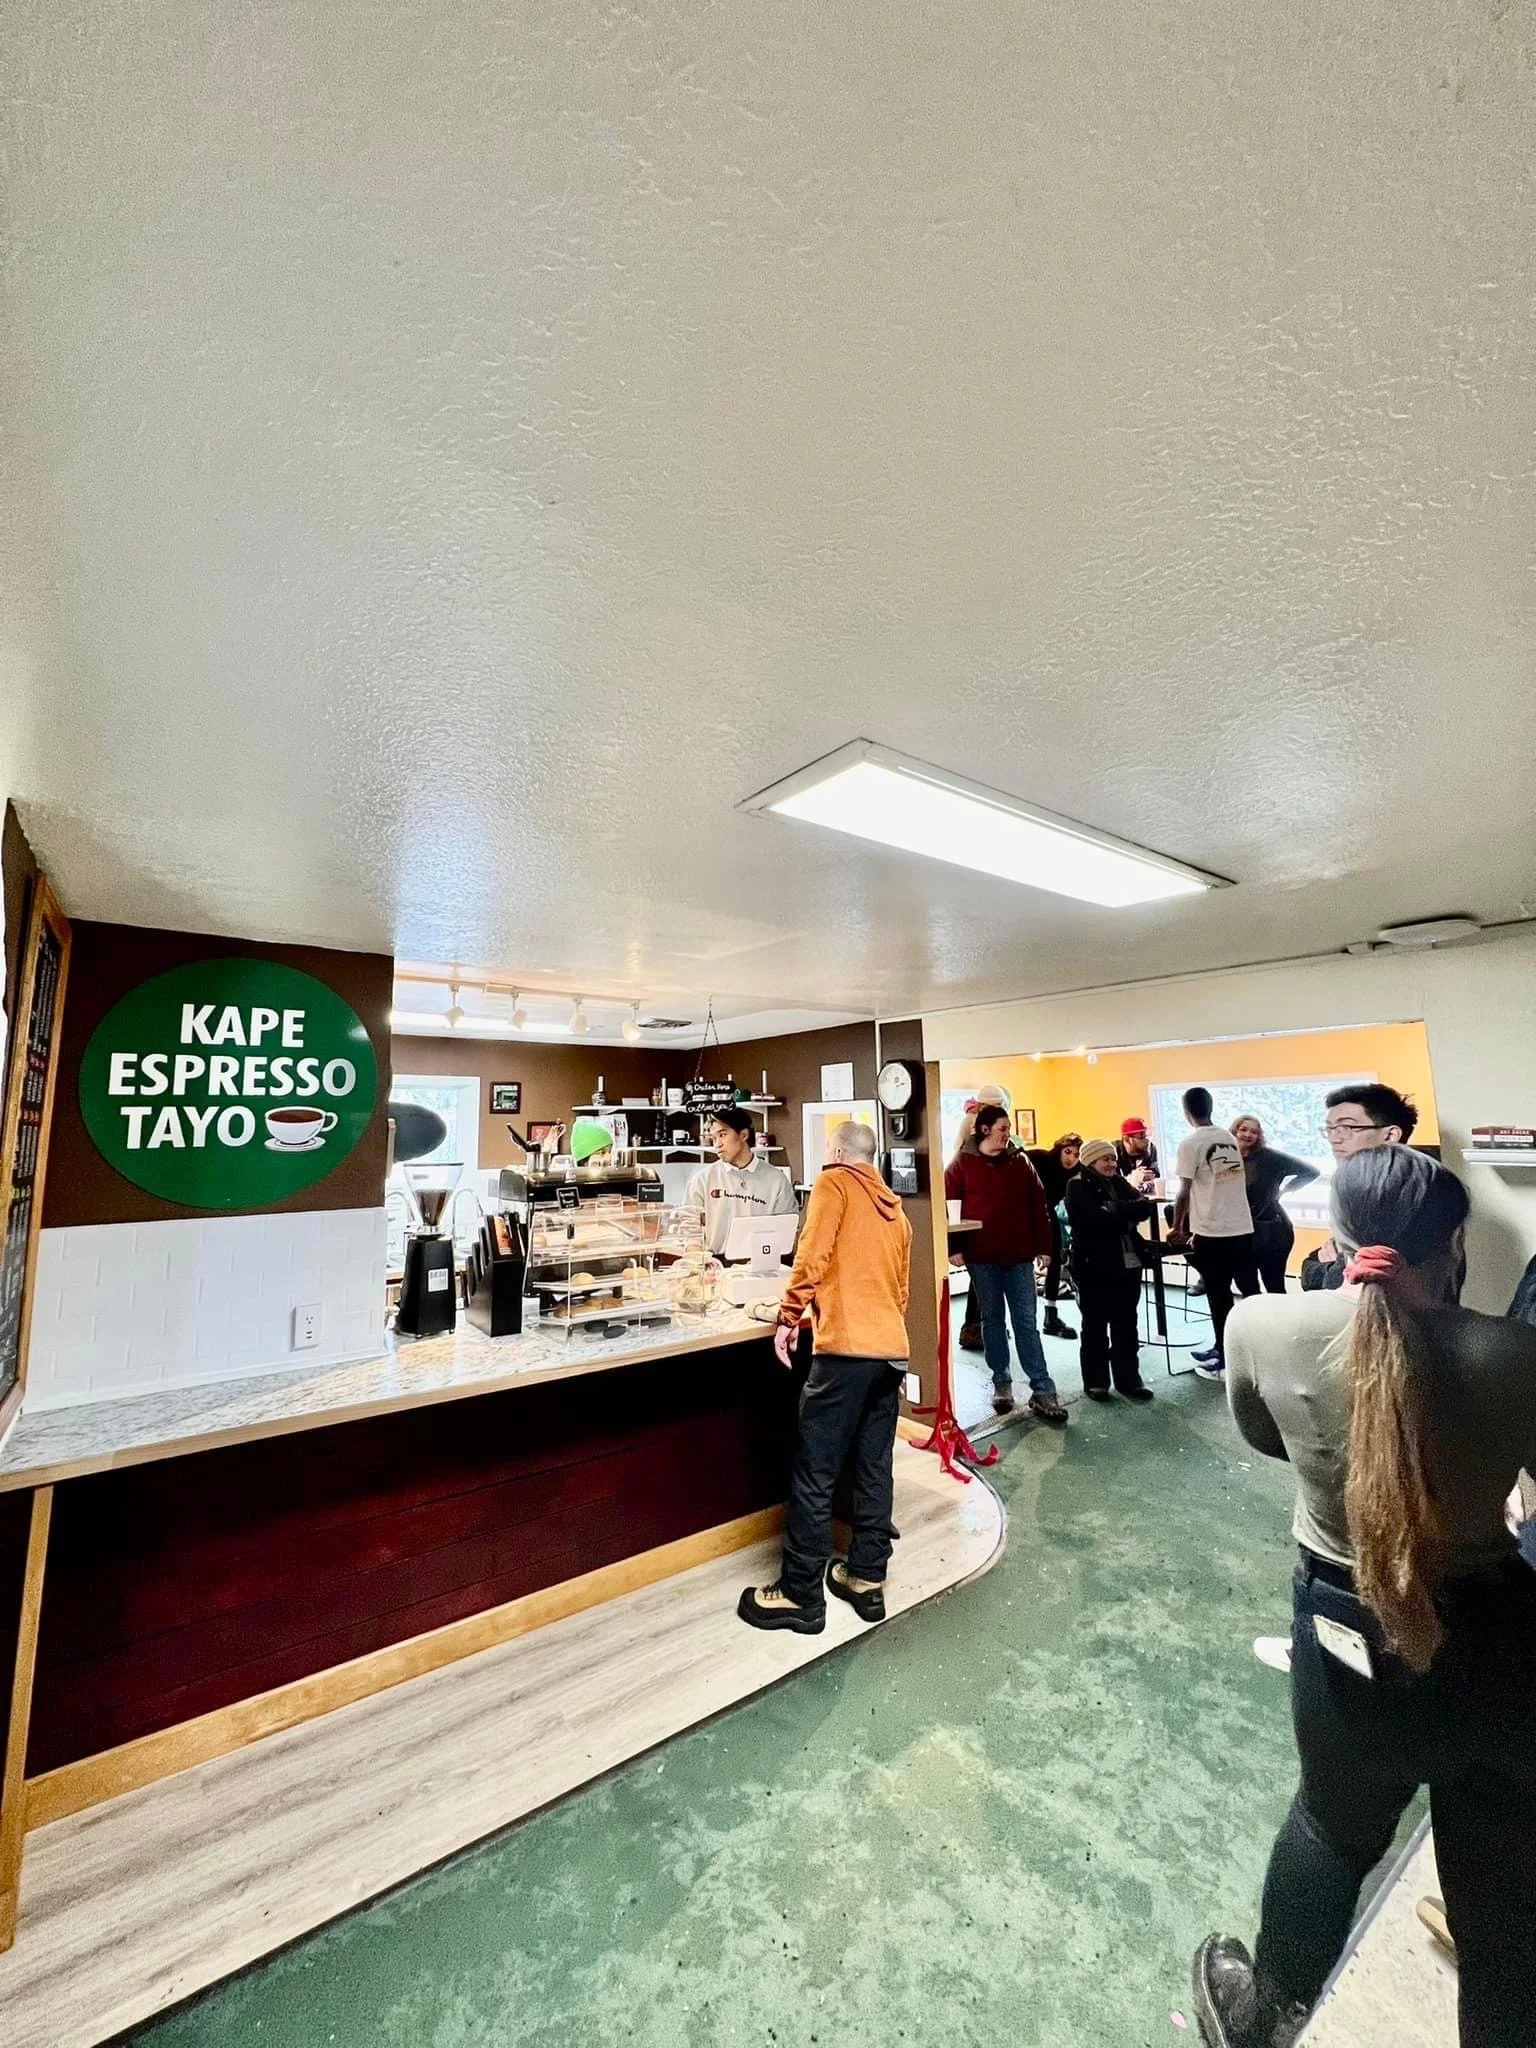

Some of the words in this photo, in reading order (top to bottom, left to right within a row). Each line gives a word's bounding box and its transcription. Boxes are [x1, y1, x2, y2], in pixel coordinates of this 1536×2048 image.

[180, 1003, 305, 1048] KAPE
[108, 1053, 357, 1096] ESPRESSO
[120, 1105, 256, 1149] TAYO
